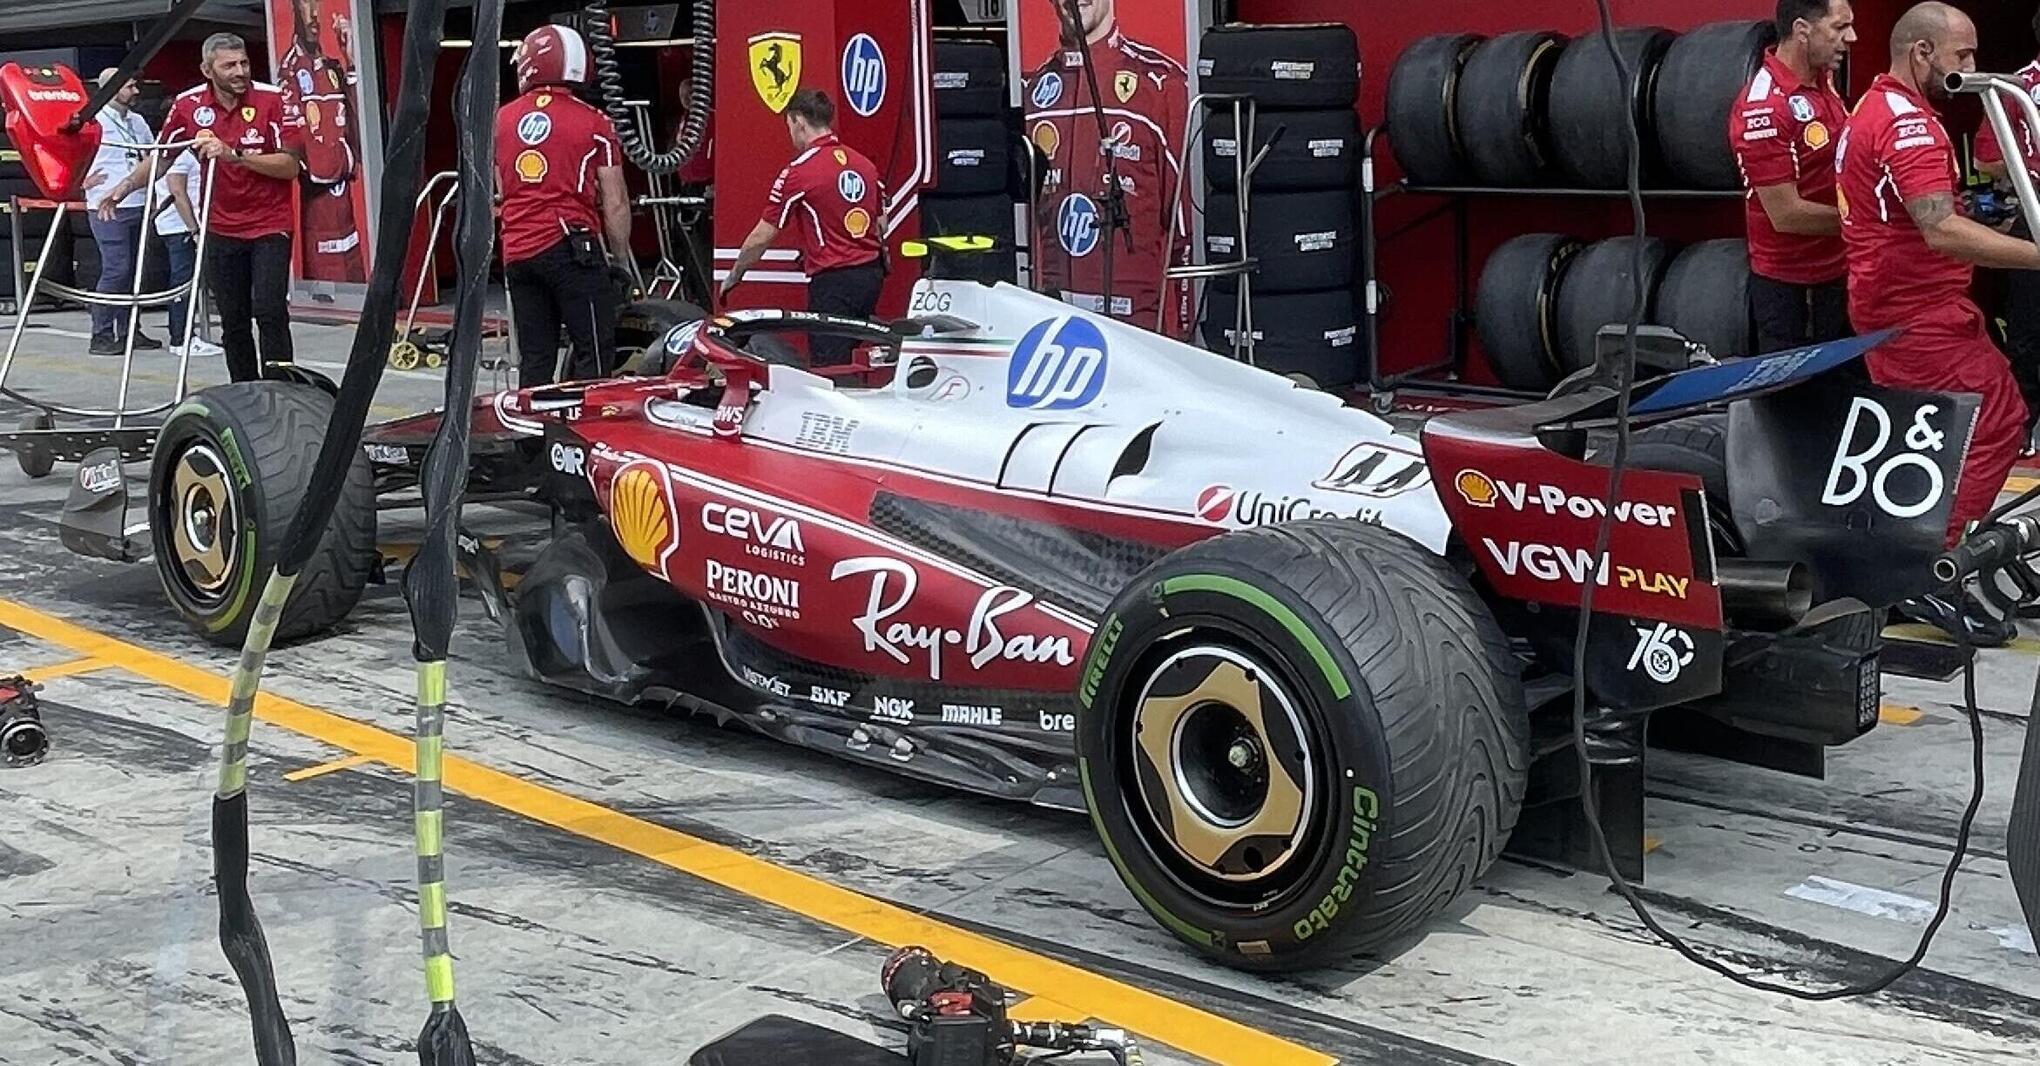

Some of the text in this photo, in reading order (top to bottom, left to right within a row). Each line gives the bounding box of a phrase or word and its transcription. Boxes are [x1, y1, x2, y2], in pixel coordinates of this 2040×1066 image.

[849, 36, 881, 112] hp
[520, 112, 549, 144] hp
[842, 172, 863, 201] hp
[1061, 195, 1096, 255] hp
[912, 291, 952, 312] ZCG
[1010, 314, 1103, 409] hp
[795, 411, 861, 453] IBM
[745, 543, 806, 567] LOGISTICS
[1482, 538, 1610, 586] VGW
[706, 559, 800, 608] PERONI
[1616, 565, 1690, 599] PLAY
[1079, 611, 1125, 710] PIRELLI
[874, 695, 915, 720] NGK
[941, 704, 1002, 726] MAHLE
[1293, 786, 1380, 941] Cinturato
